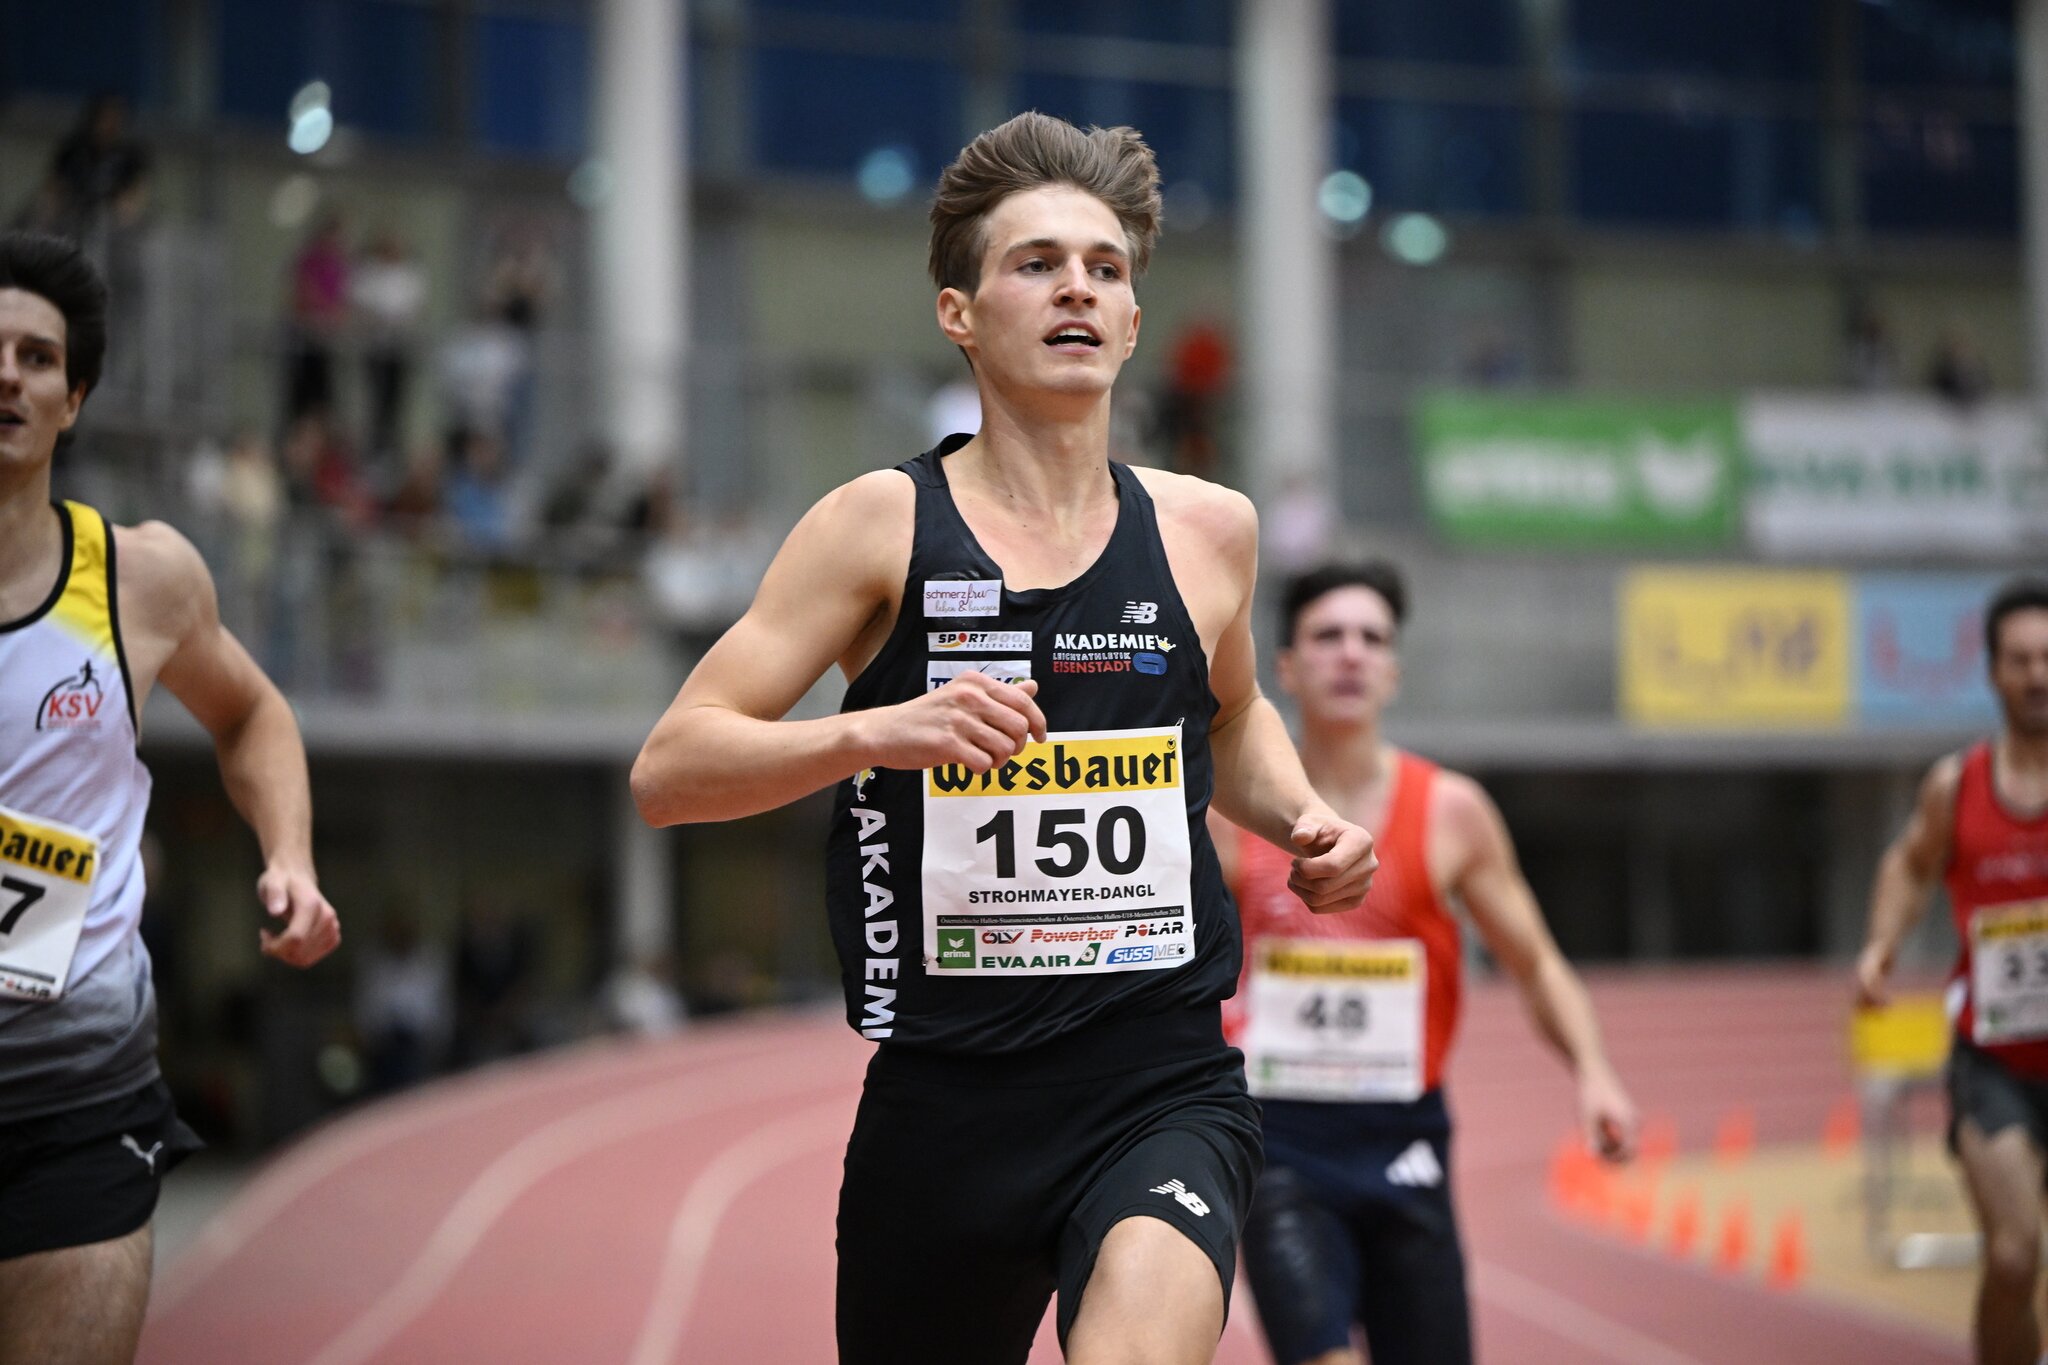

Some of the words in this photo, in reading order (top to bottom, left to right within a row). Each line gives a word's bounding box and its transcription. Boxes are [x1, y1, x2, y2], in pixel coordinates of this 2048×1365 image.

[1054, 633, 1156, 650] AKADEMIE
[1053, 652, 1131, 661] LEICHTATHLETIK
[1053, 660, 1131, 673] EISENSTADT
[48, 692, 103, 718] KSV
[976, 805, 1146, 878] 150
[0, 827, 93, 879] auer
[968, 884, 1155, 904] STROHMAYER-DANGL
[0, 875, 46, 935] 7
[1030, 927, 1118, 942] Powerbar
[1125, 922, 1184, 937] POLAR
[943, 950, 971, 958] erima
[982, 956, 1027, 968] EVA
[1030, 954, 1070, 967] AIR
